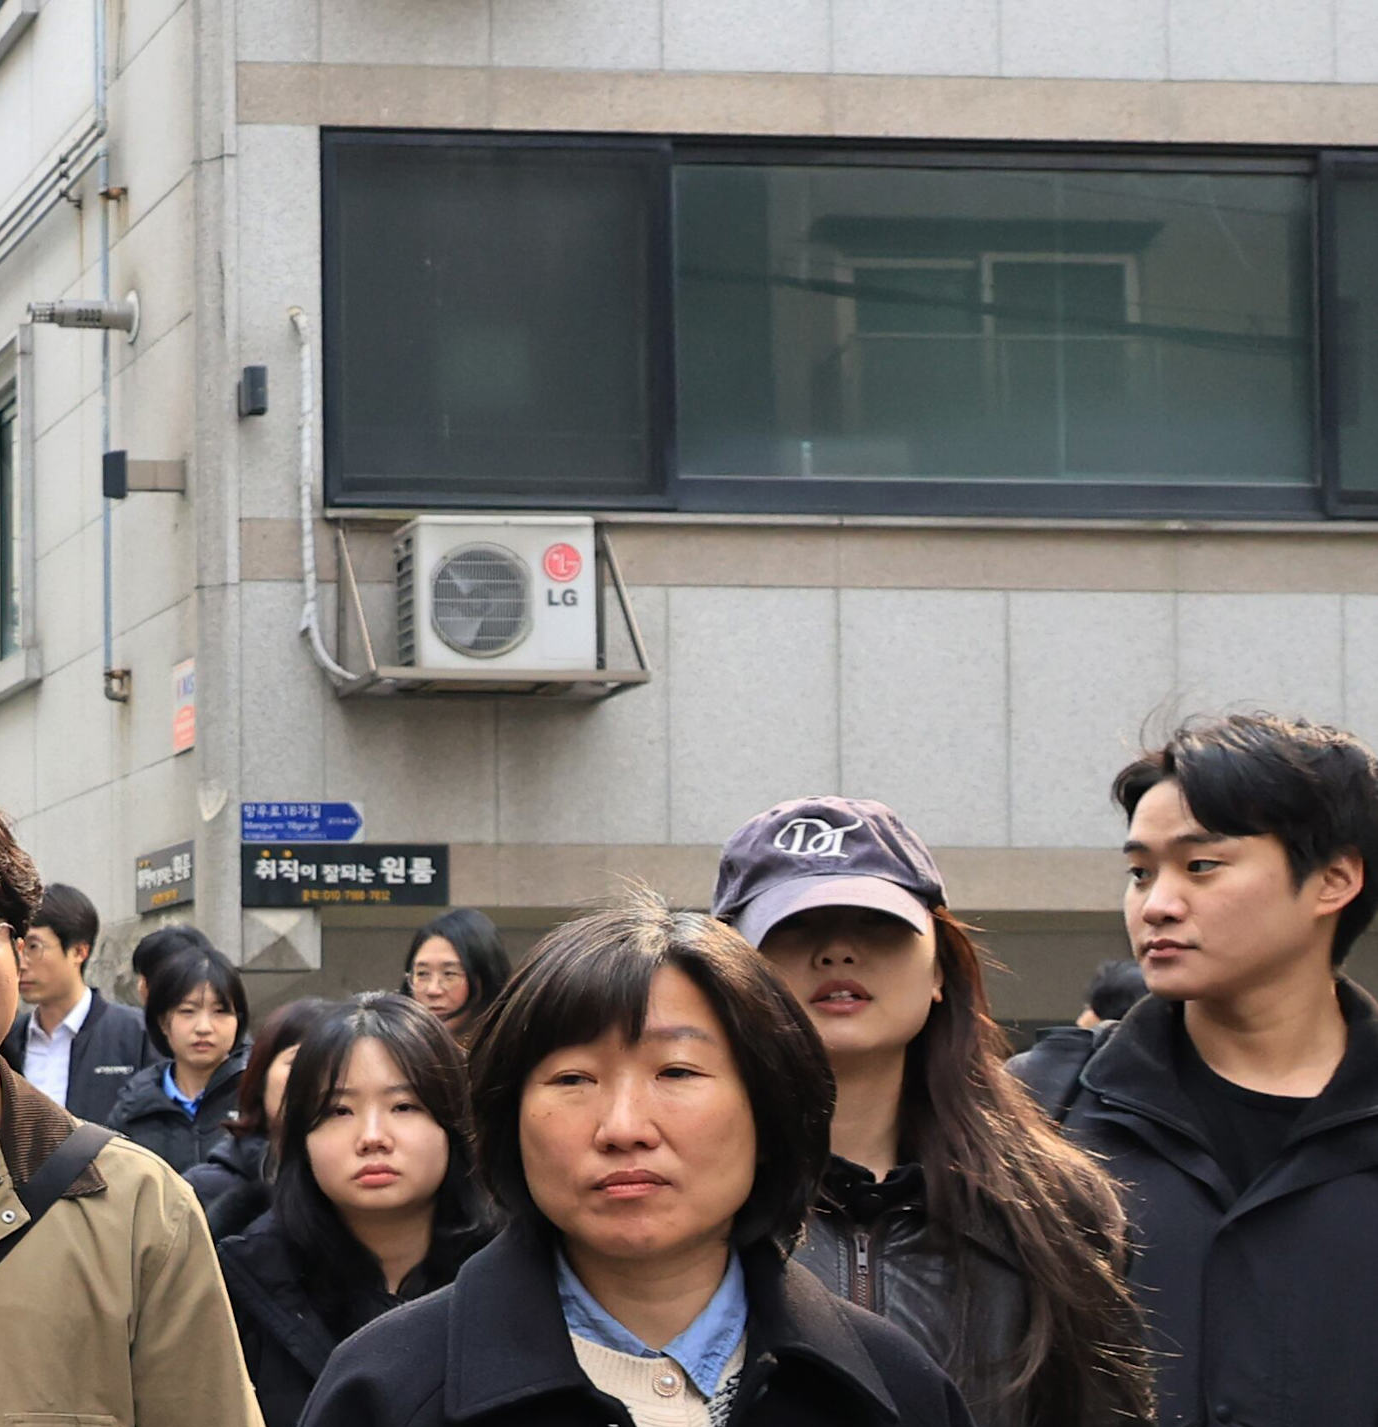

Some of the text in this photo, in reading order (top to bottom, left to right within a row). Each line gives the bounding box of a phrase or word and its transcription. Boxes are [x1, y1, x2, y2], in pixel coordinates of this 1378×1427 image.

[547, 589, 578, 607] LG
[255, 856, 437, 884] 취직이 잘되는 원룸
